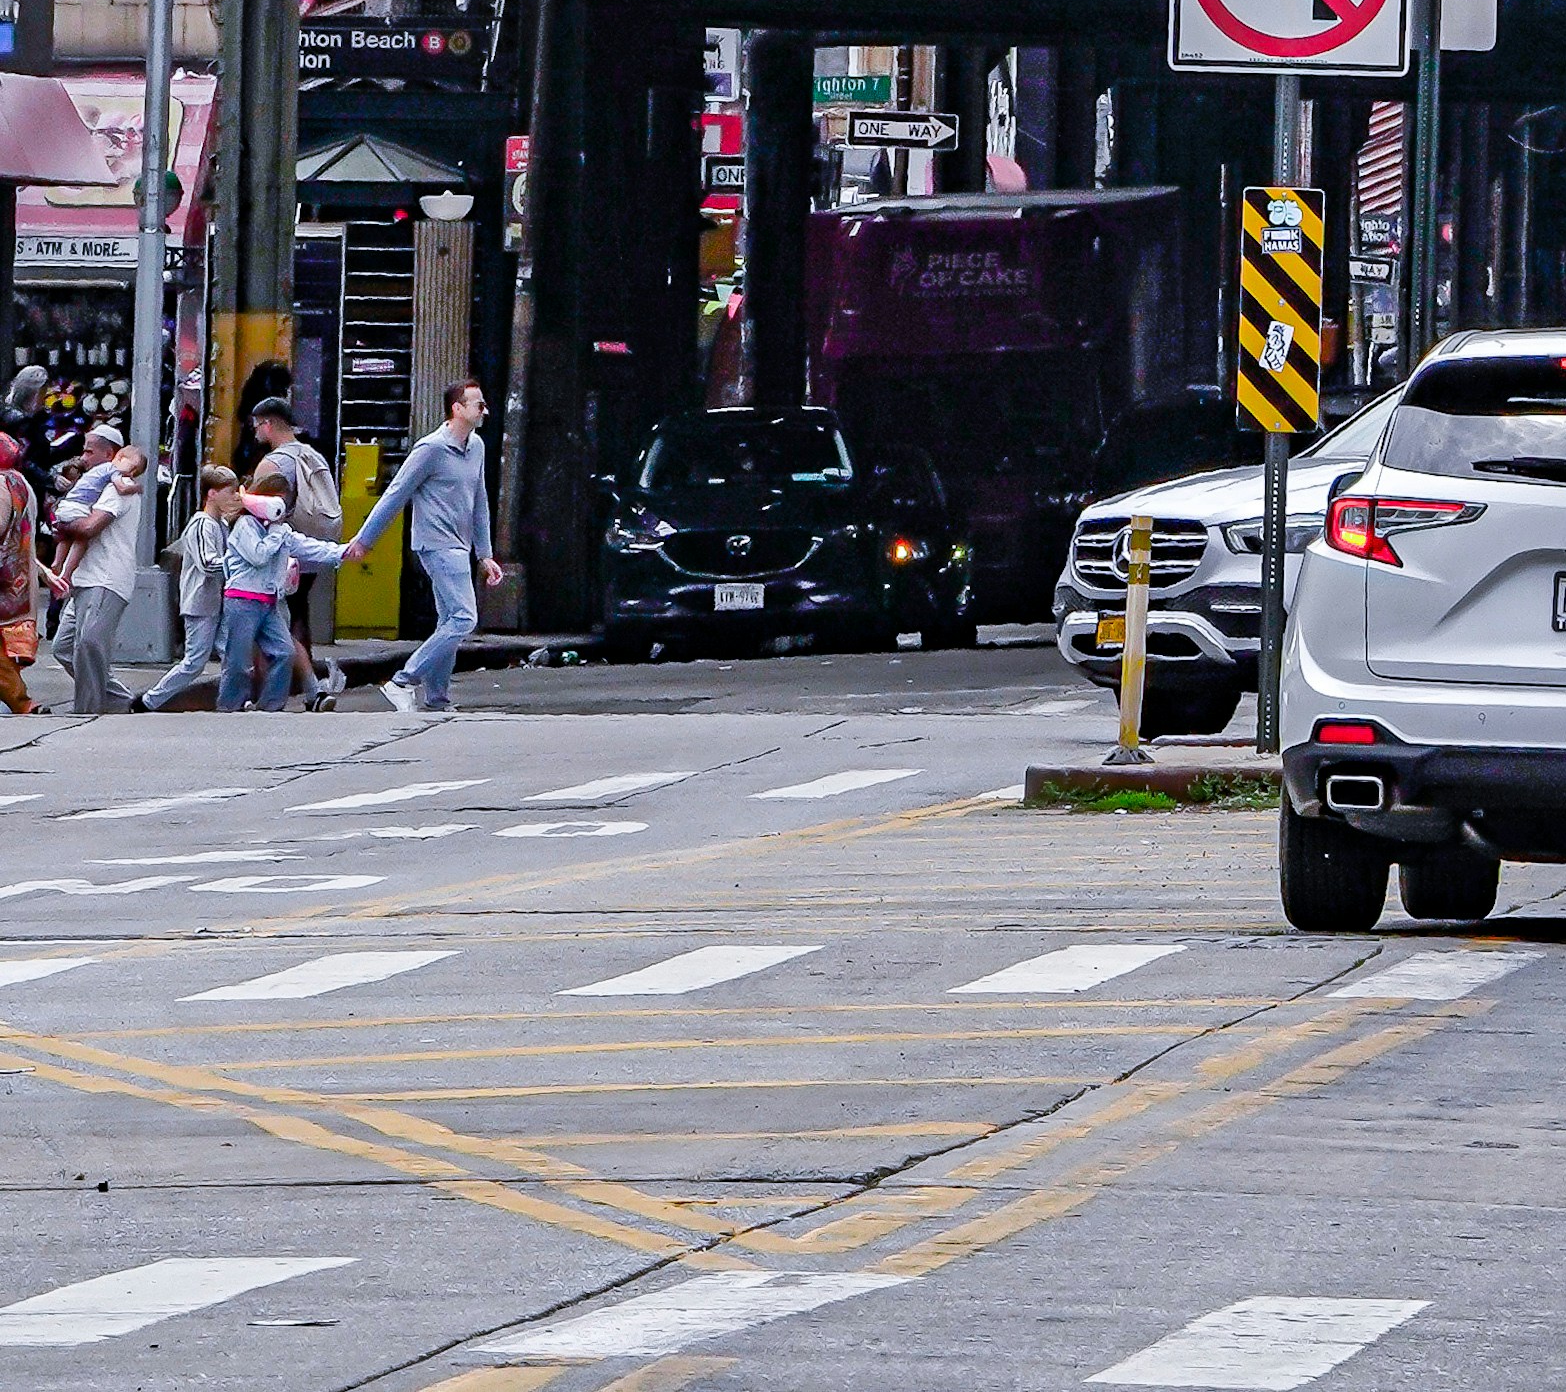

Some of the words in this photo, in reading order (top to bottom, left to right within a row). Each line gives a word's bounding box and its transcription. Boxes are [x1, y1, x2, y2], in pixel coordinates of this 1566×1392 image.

[351, 30, 416, 49] Beach
[858, 122, 890, 136] ONE
[908, 123, 942, 138] WAY
[36, 241, 63, 255] ATM
[69, 242, 78, 255] &
[1264, 241, 1299, 251] HAMAS
[928, 252, 1000, 268] PIECE
[919, 270, 953, 288] OF
[959, 268, 1030, 286] CAKE
